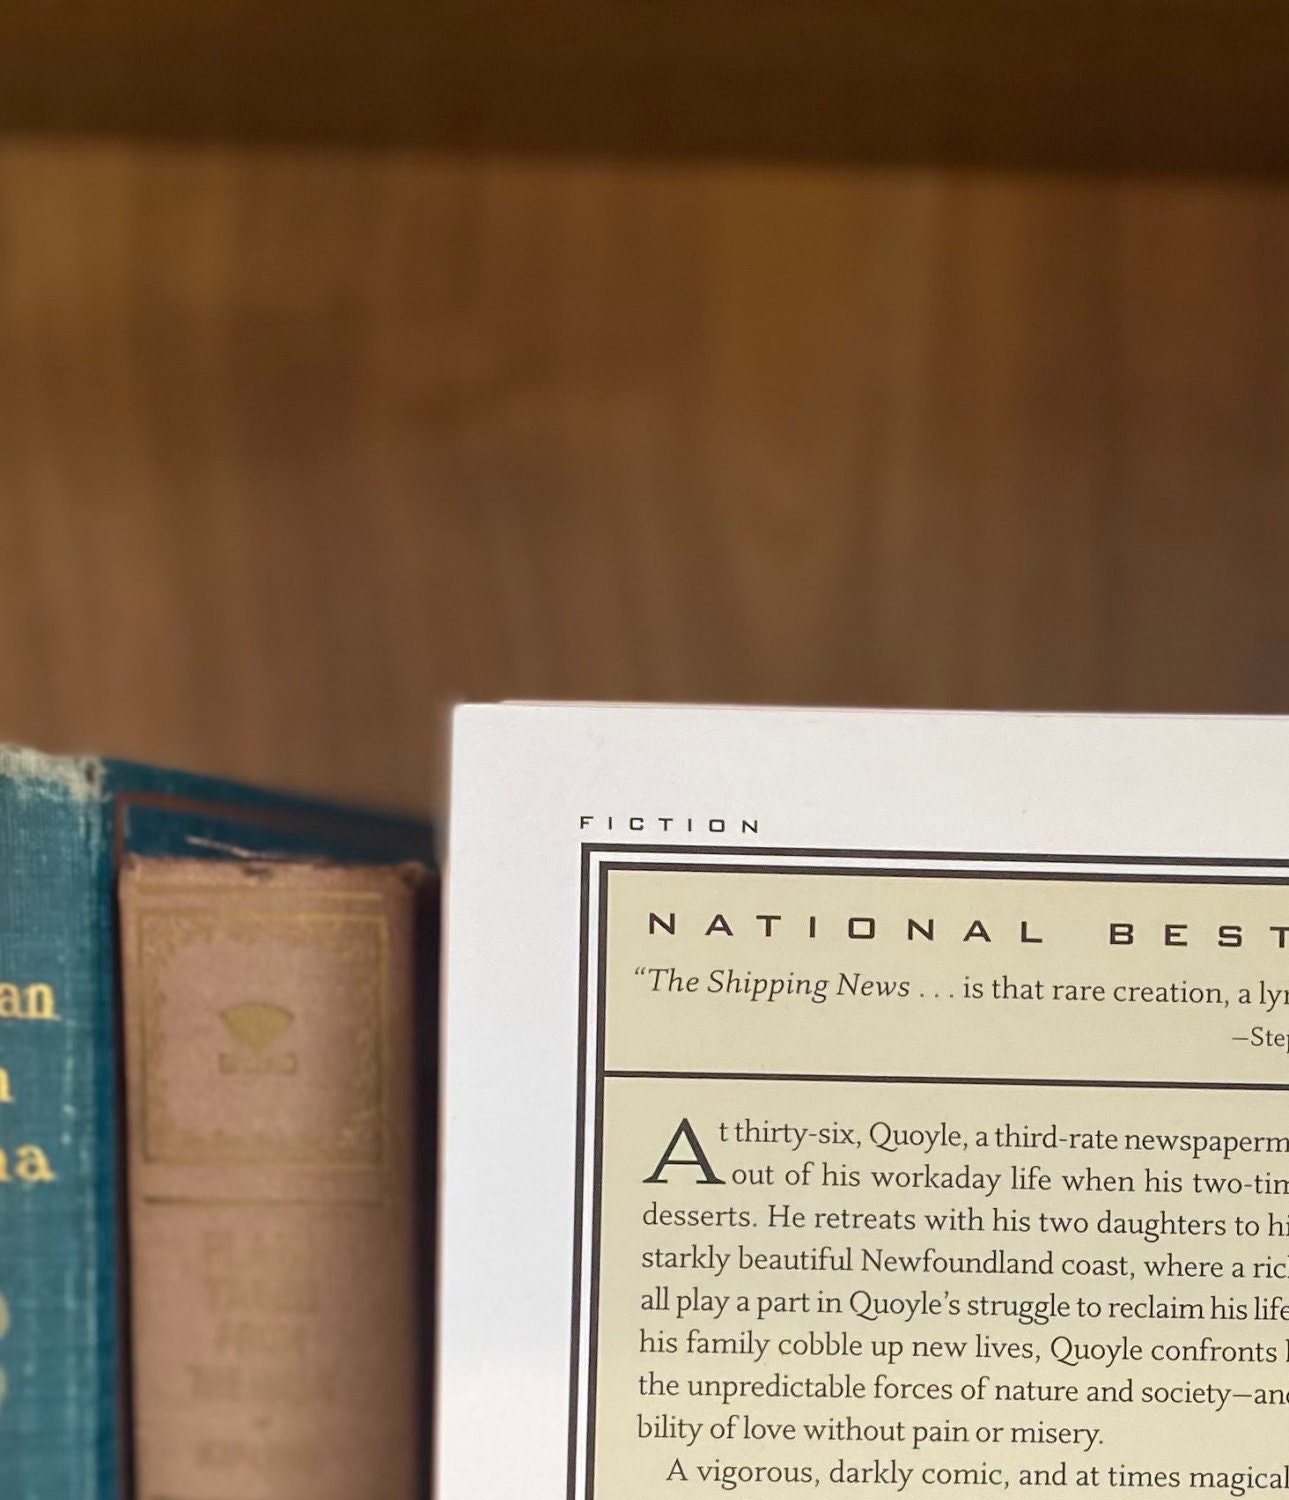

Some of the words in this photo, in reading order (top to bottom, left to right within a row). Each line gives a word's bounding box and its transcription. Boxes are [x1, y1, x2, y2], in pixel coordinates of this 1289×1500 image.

[579, 814, 759, 835] FICTION
[647, 911, 1044, 945] NATIONAL
[732, 1117, 863, 1153] thirty-six,
[868, 1120, 970, 1155] Quoyle,
[975, 1130, 991, 1148] a
[993, 1122, 1120, 1151] third-rate
[640, 1243, 732, 1278] starkly
[736, 1243, 855, 1272] beautiful
[859, 1246, 1055, 1276] Newfoundland
[1060, 1255, 1136, 1282] coast,
[1142, 1250, 1225, 1279] where
[1231, 1261, 1246, 1280] a
[635, 1412, 705, 1449] bility
[708, 1413, 741, 1441] of
[742, 1413, 797, 1441] love
[802, 1414, 907, 1443] without
[910, 1418, 971, 1451] pain
[974, 1426, 1006, 1444] or
[1009, 1420, 1105, 1453] misery.
